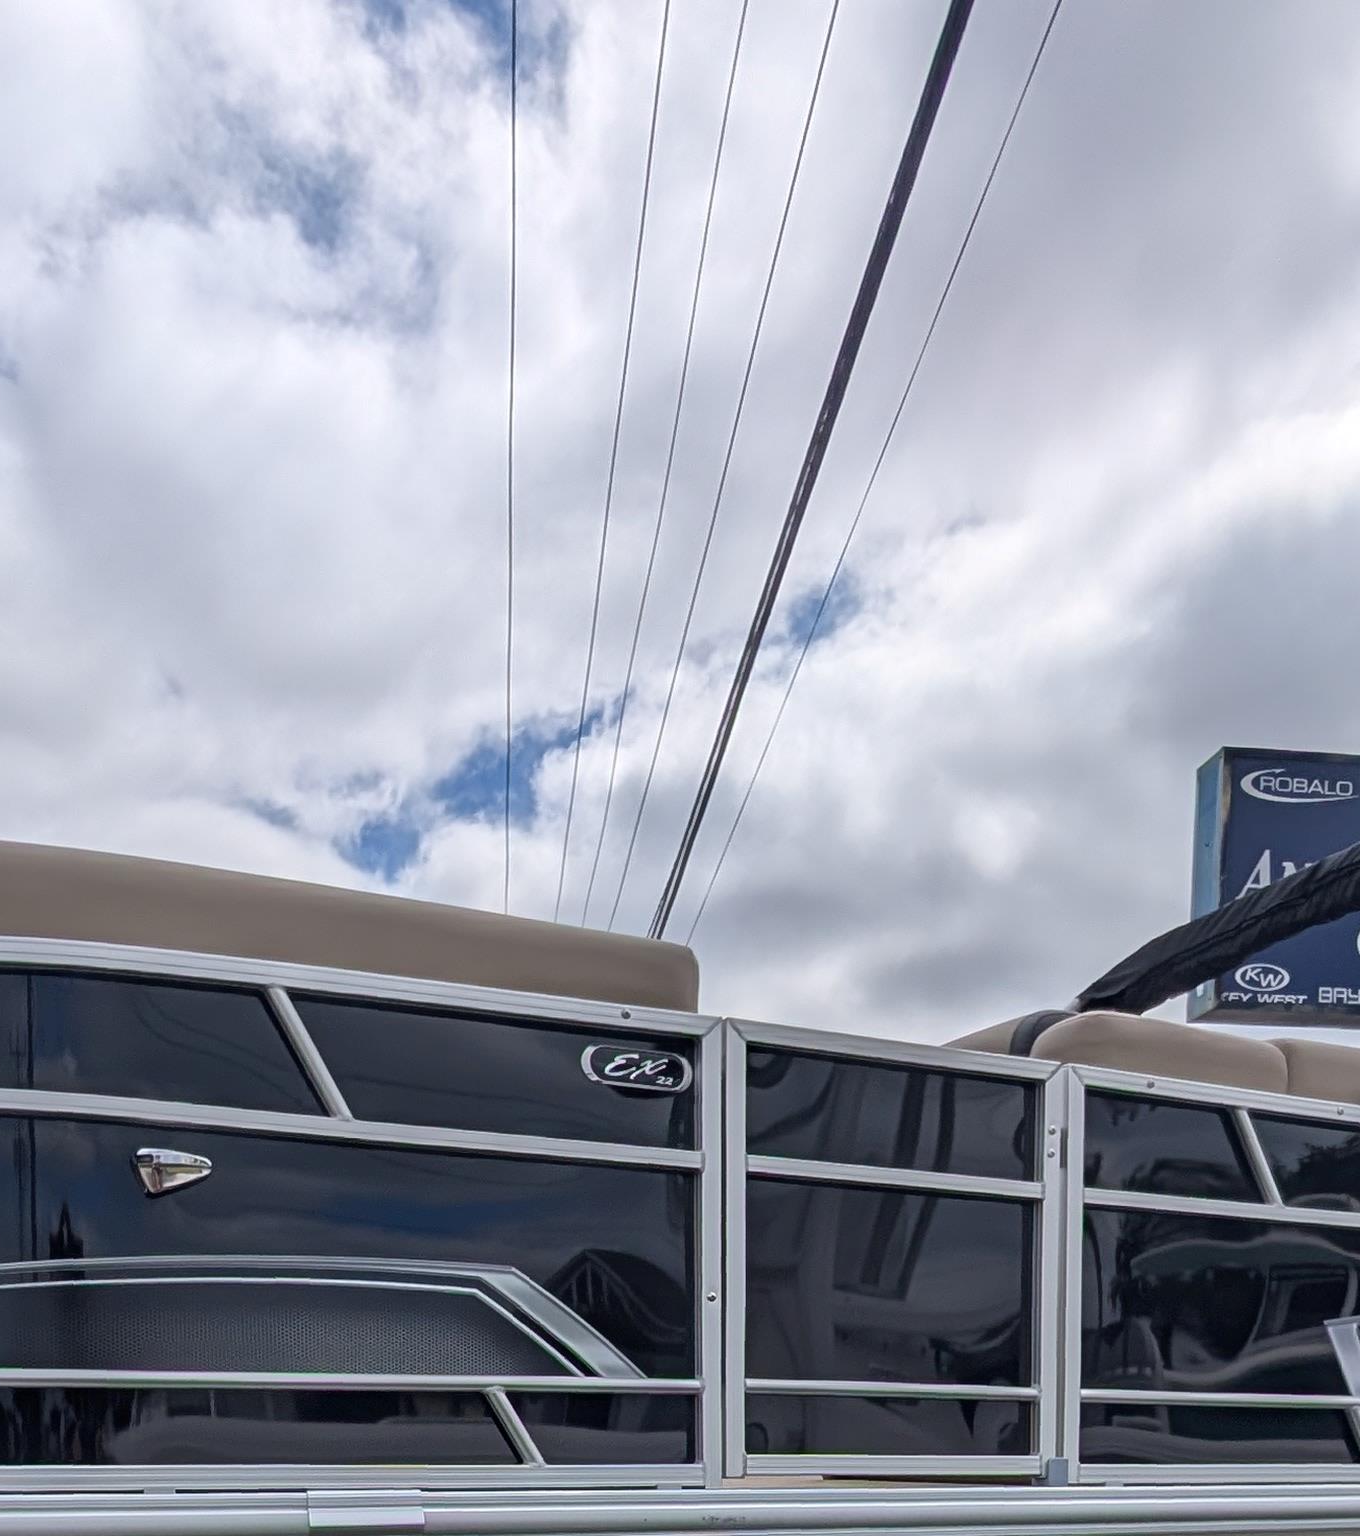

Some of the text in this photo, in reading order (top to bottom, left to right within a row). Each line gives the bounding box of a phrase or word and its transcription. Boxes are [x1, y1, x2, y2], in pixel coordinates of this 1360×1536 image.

[1258, 776, 1354, 797] ROBALO
[1244, 967, 1284, 988] KW
[655, 1075, 674, 1086] 22
